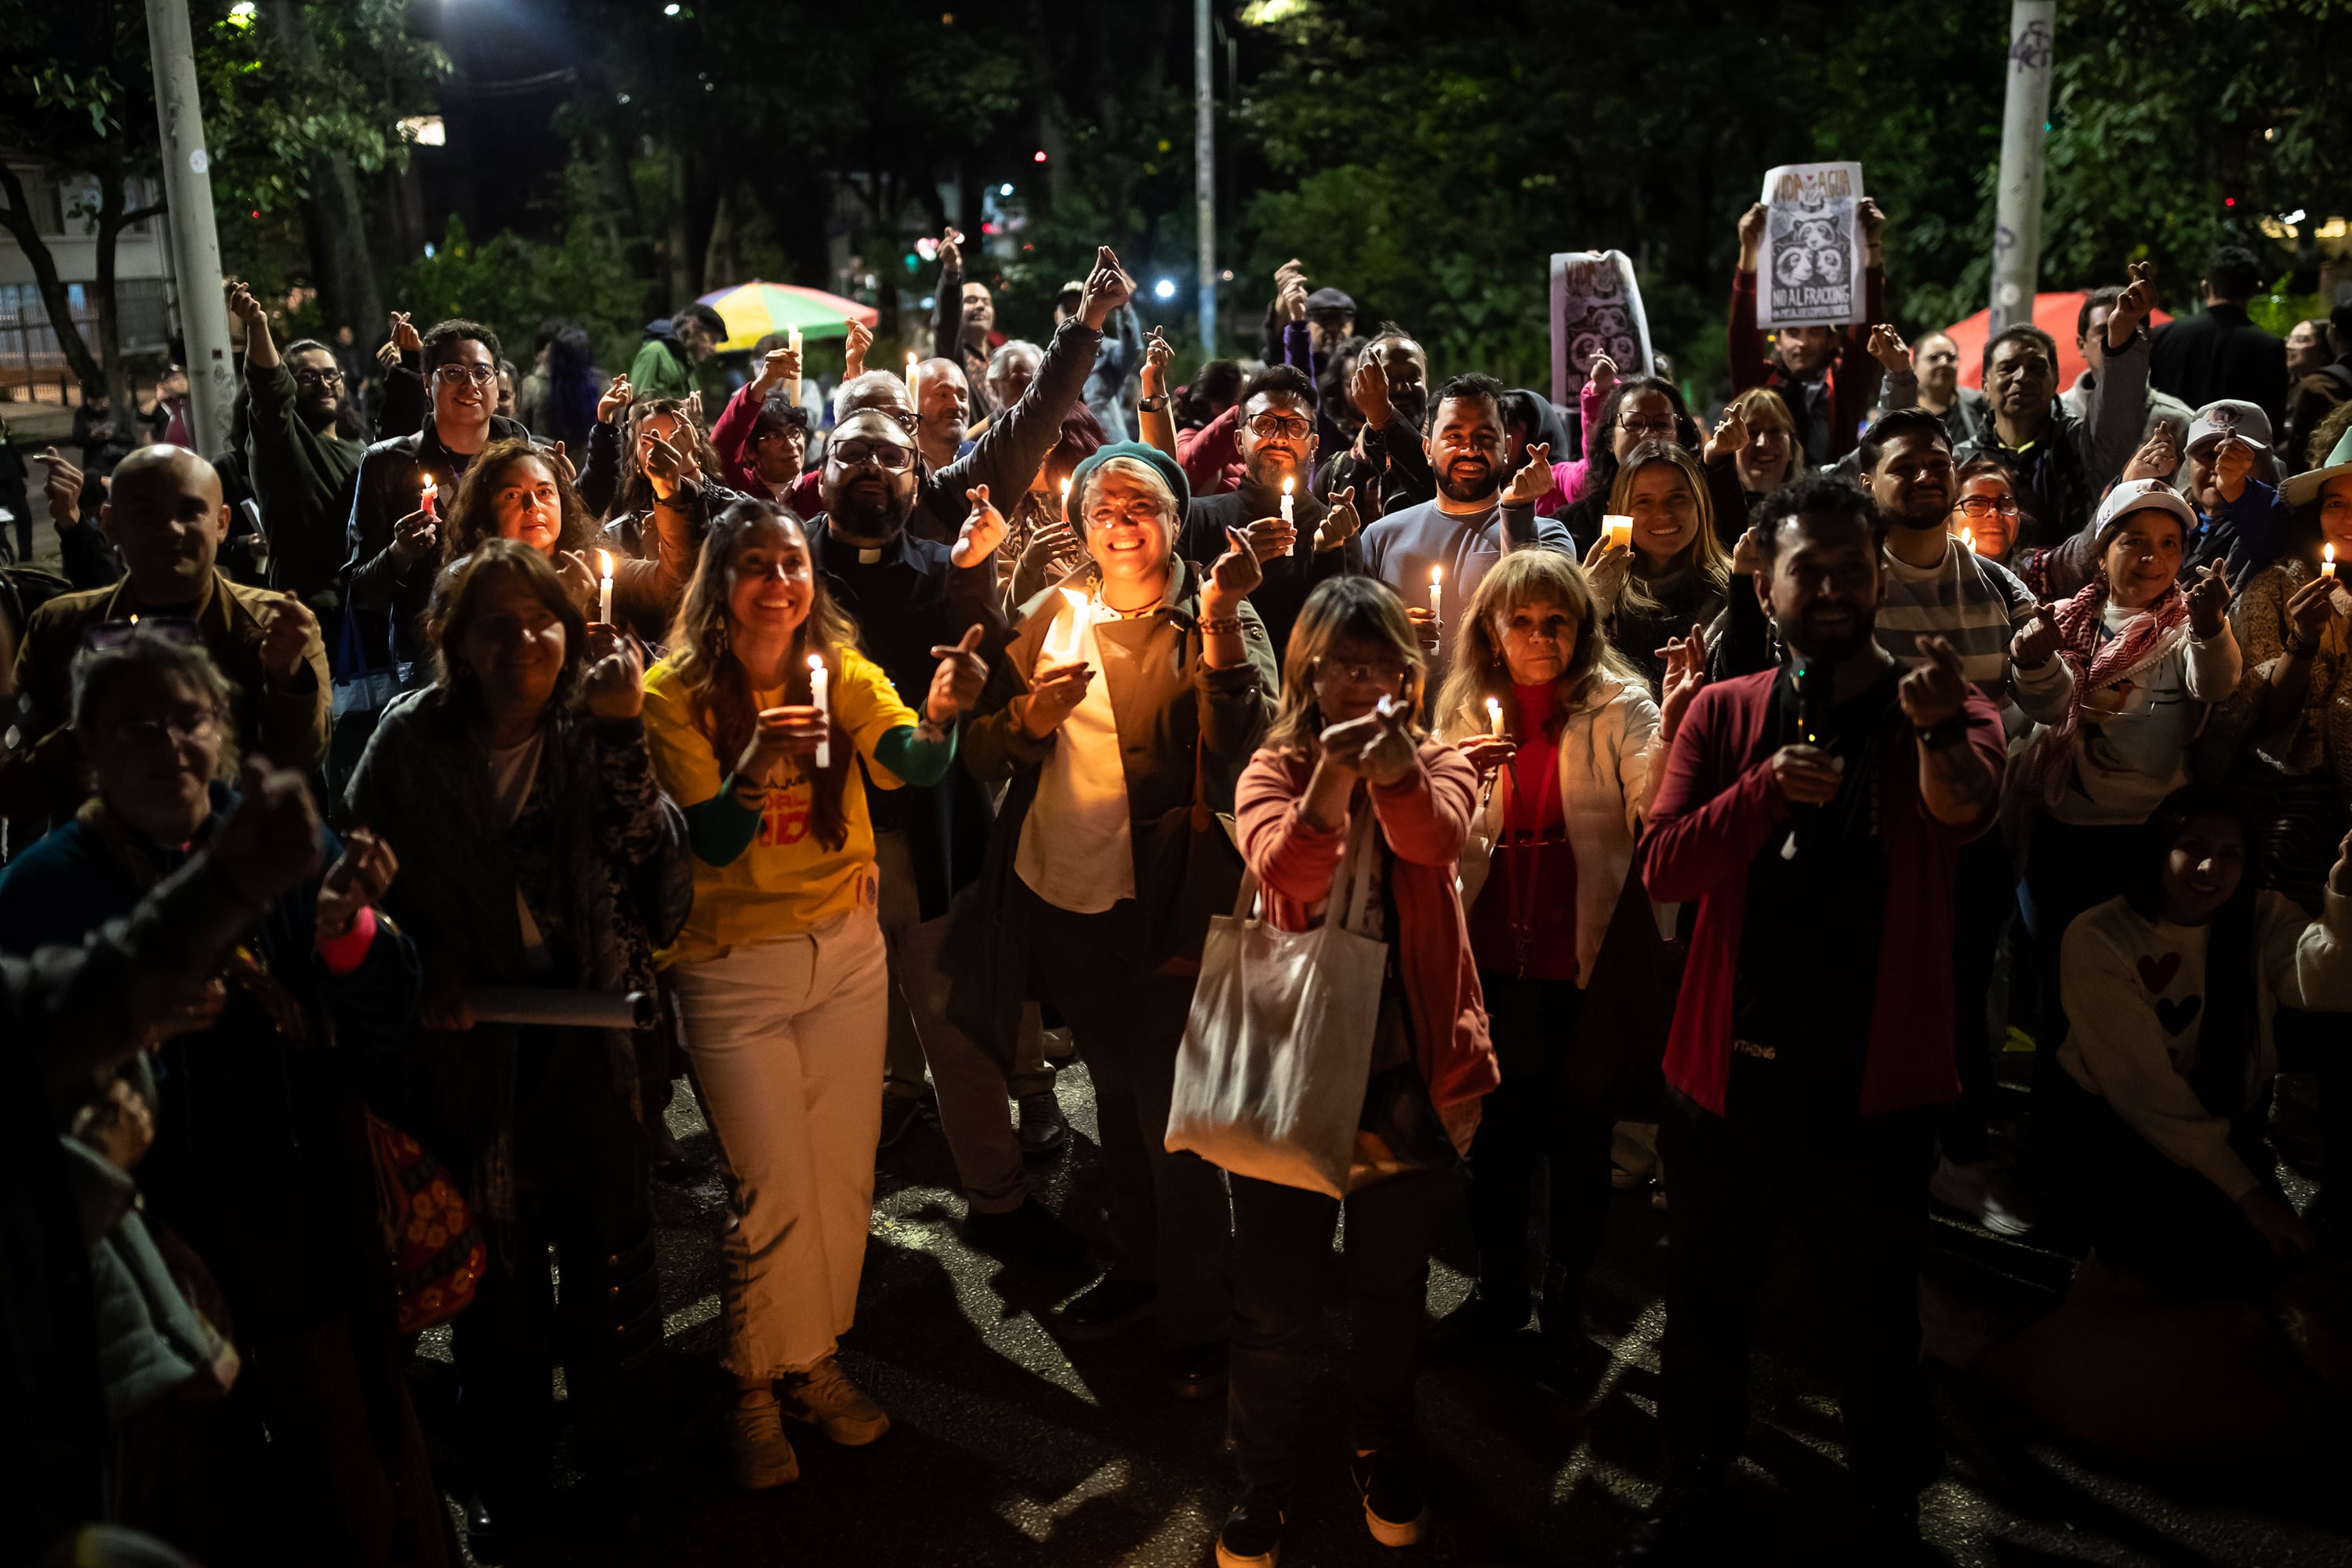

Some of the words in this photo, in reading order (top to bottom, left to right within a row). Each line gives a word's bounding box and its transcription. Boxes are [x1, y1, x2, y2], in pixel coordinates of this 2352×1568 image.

[1773, 173, 1804, 201] VIDA
[1818, 169, 1851, 198] AGUA
[1773, 289, 1787, 307] NO
[1788, 288, 1803, 307] AL
[1803, 284, 1849, 306] FRACKING
